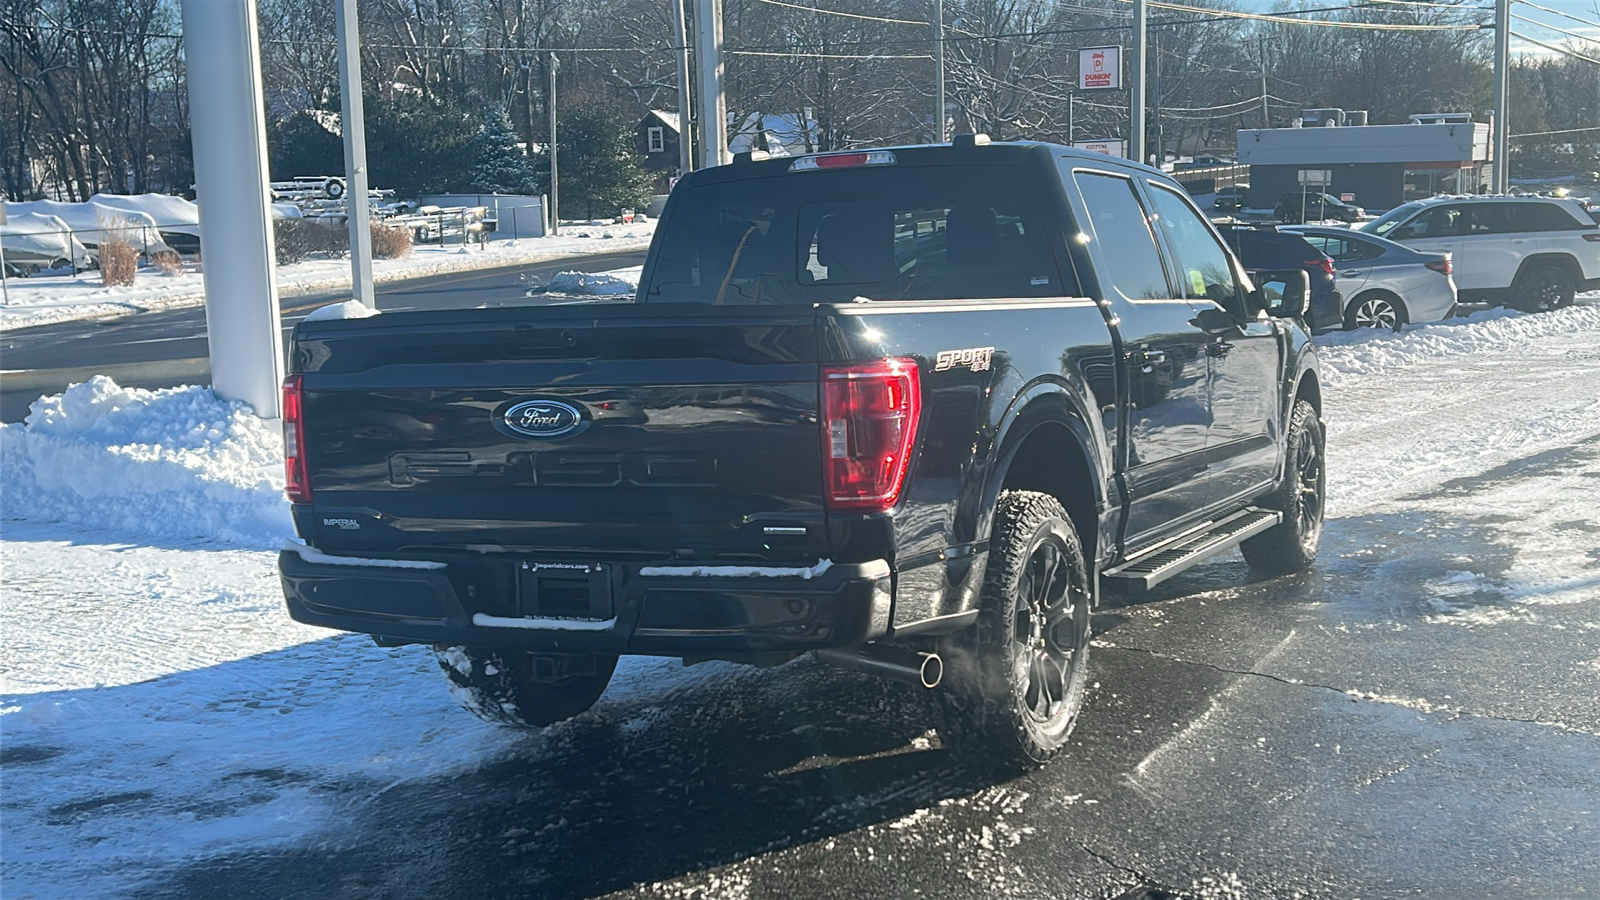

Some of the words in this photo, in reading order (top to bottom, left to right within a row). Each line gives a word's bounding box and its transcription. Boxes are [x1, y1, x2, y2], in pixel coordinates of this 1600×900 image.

[935, 346, 995, 371] SPORT
[520, 407, 561, 428] Ford
[323, 518, 358, 526] IMPERIAL
